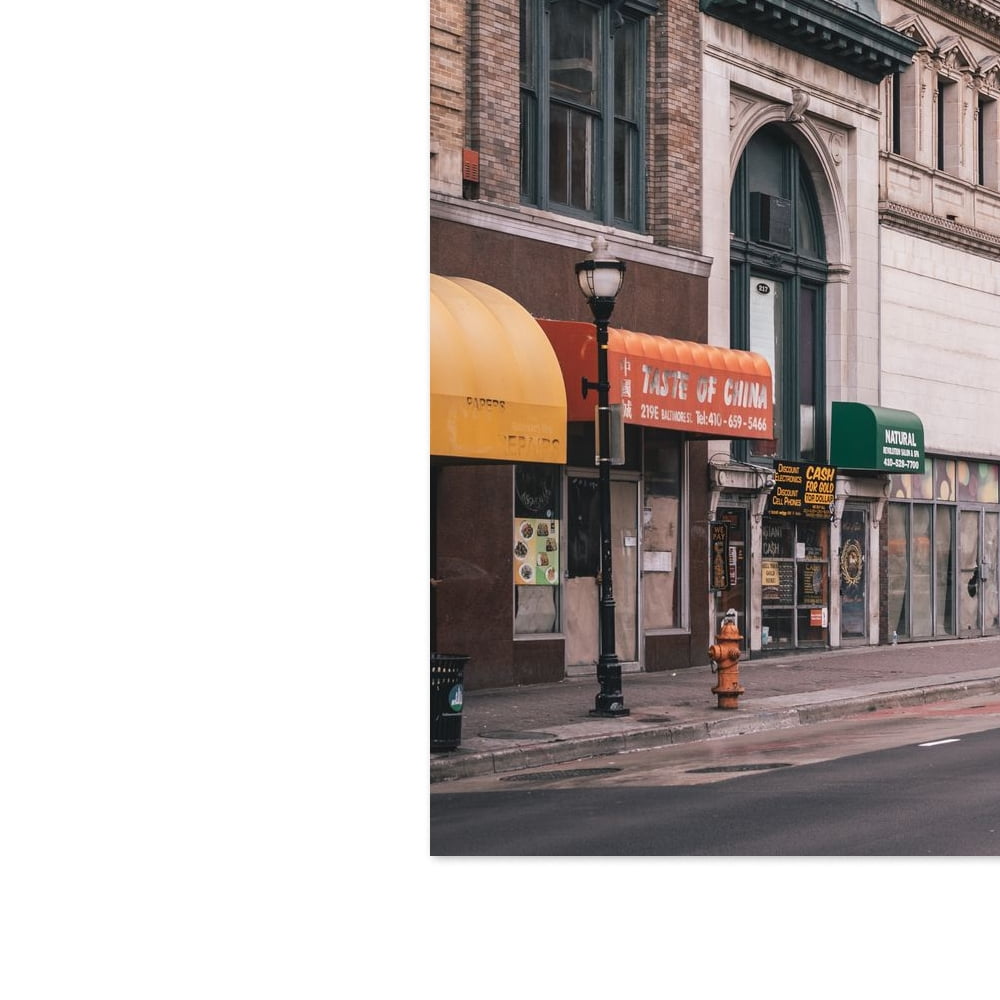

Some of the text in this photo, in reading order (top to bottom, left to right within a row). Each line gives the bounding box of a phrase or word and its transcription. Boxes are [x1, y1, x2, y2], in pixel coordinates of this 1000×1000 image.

[758, 284, 769, 293] 217
[641, 363, 769, 410] TASTE OF CHINA
[885, 429, 917, 447] NATURAL
[805, 465, 836, 481] CASH
[805, 481, 835, 494] FOR GOLD
